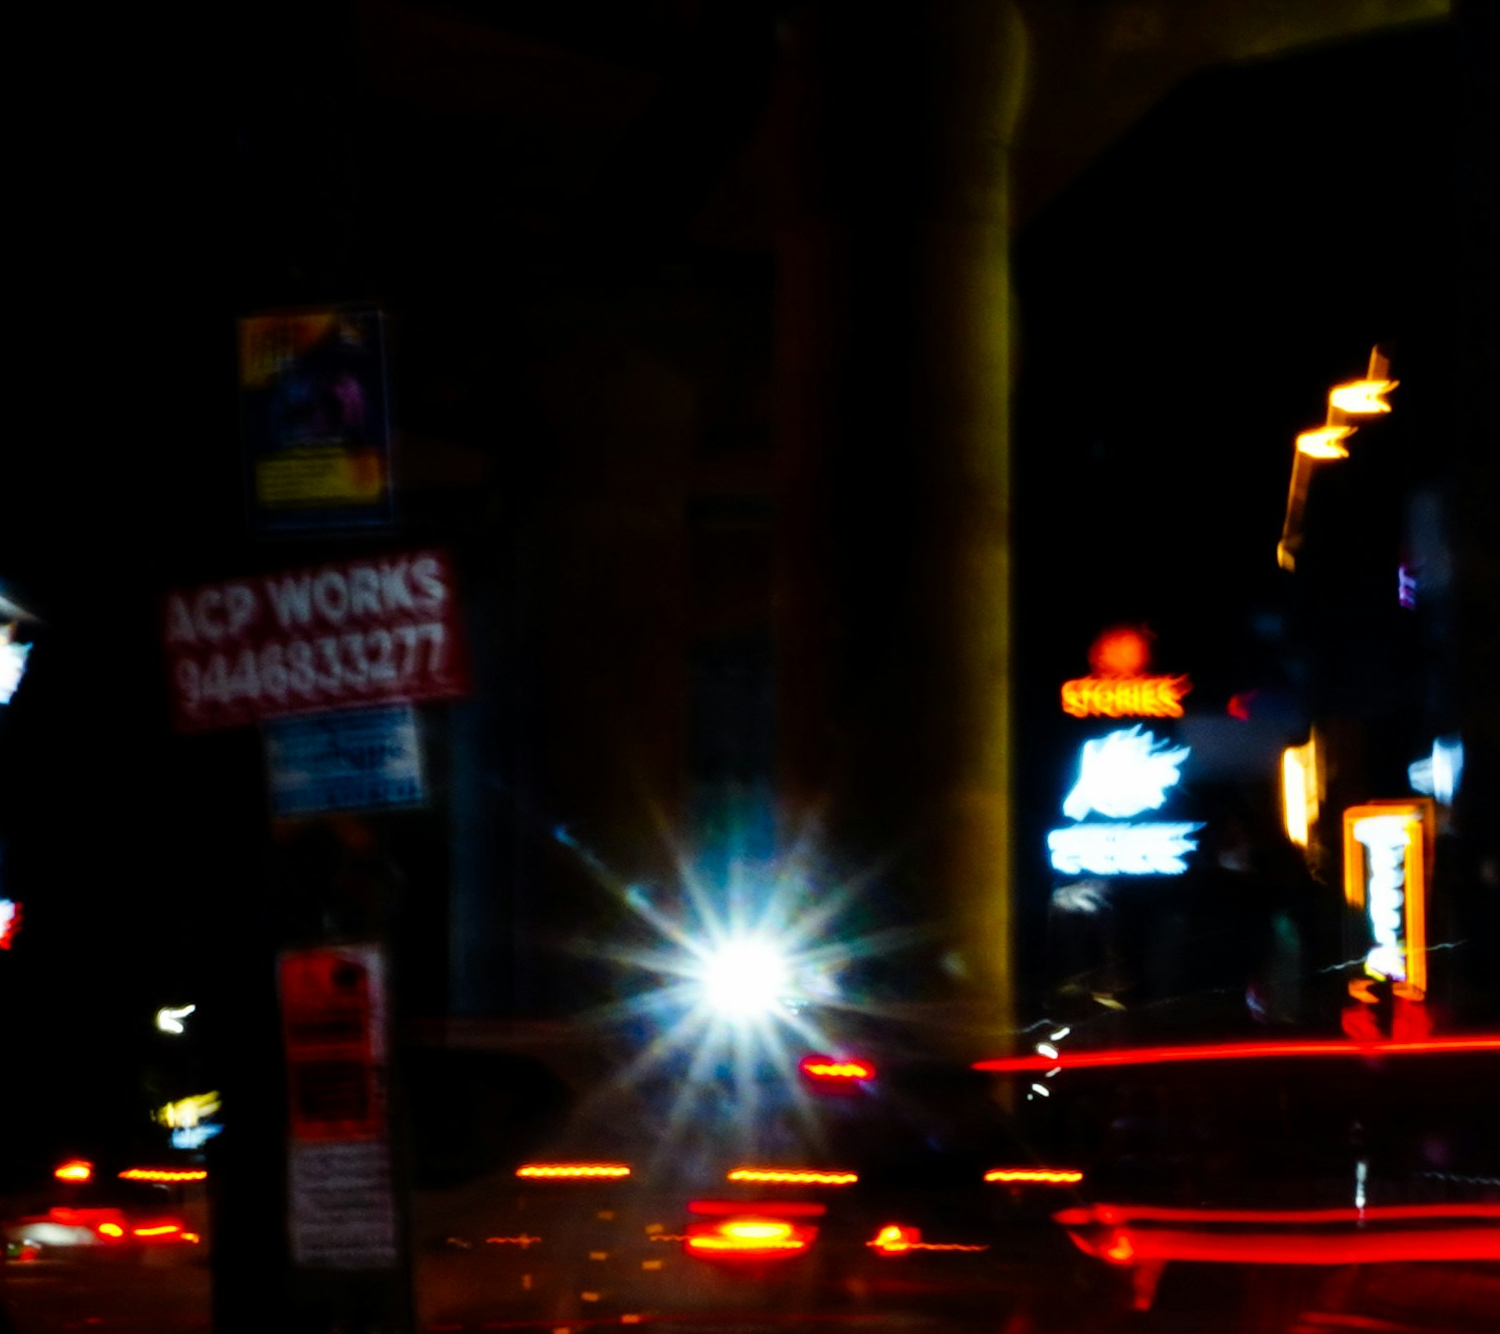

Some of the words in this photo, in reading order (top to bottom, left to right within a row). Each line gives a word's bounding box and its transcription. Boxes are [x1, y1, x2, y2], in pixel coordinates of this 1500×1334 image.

[165, 584, 258, 645] ACP
[263, 555, 450, 629] WORKS
[174, 622, 446, 715] 9446833277
